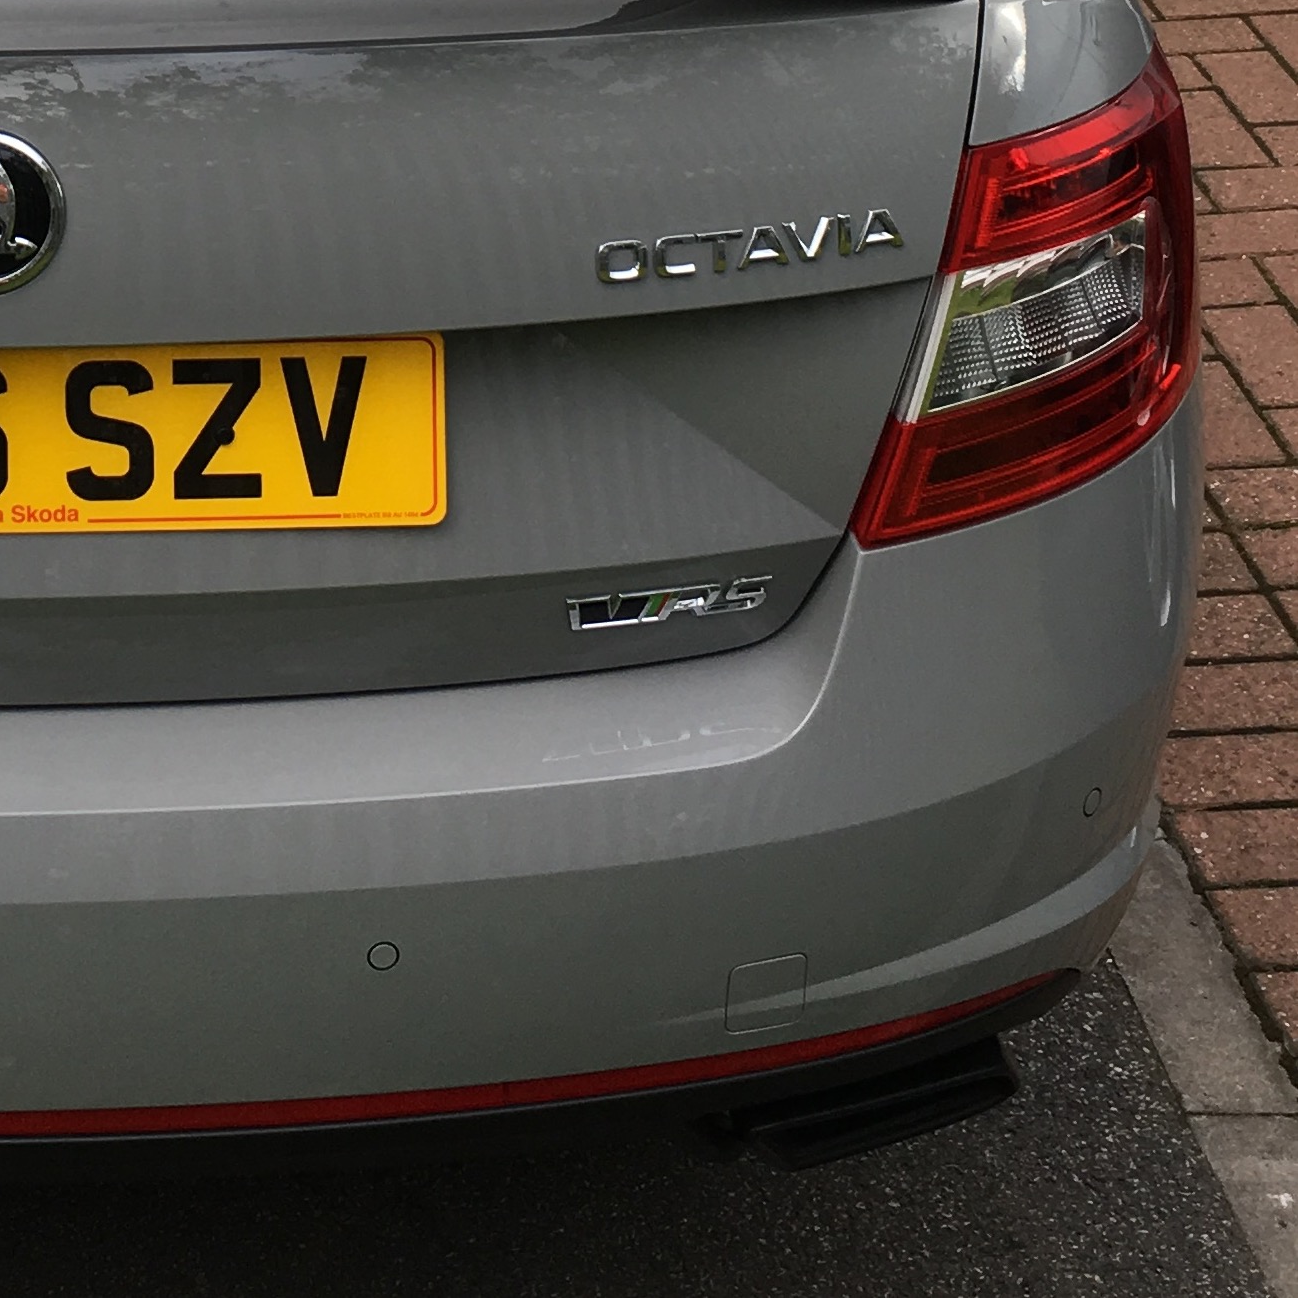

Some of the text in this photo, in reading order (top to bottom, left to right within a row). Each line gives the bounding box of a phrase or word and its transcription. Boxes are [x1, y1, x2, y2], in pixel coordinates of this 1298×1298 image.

[595, 208, 904, 283] OCTAVIA
[65, 356, 367, 501] SZV
[11, 504, 79, 523] Skoda
